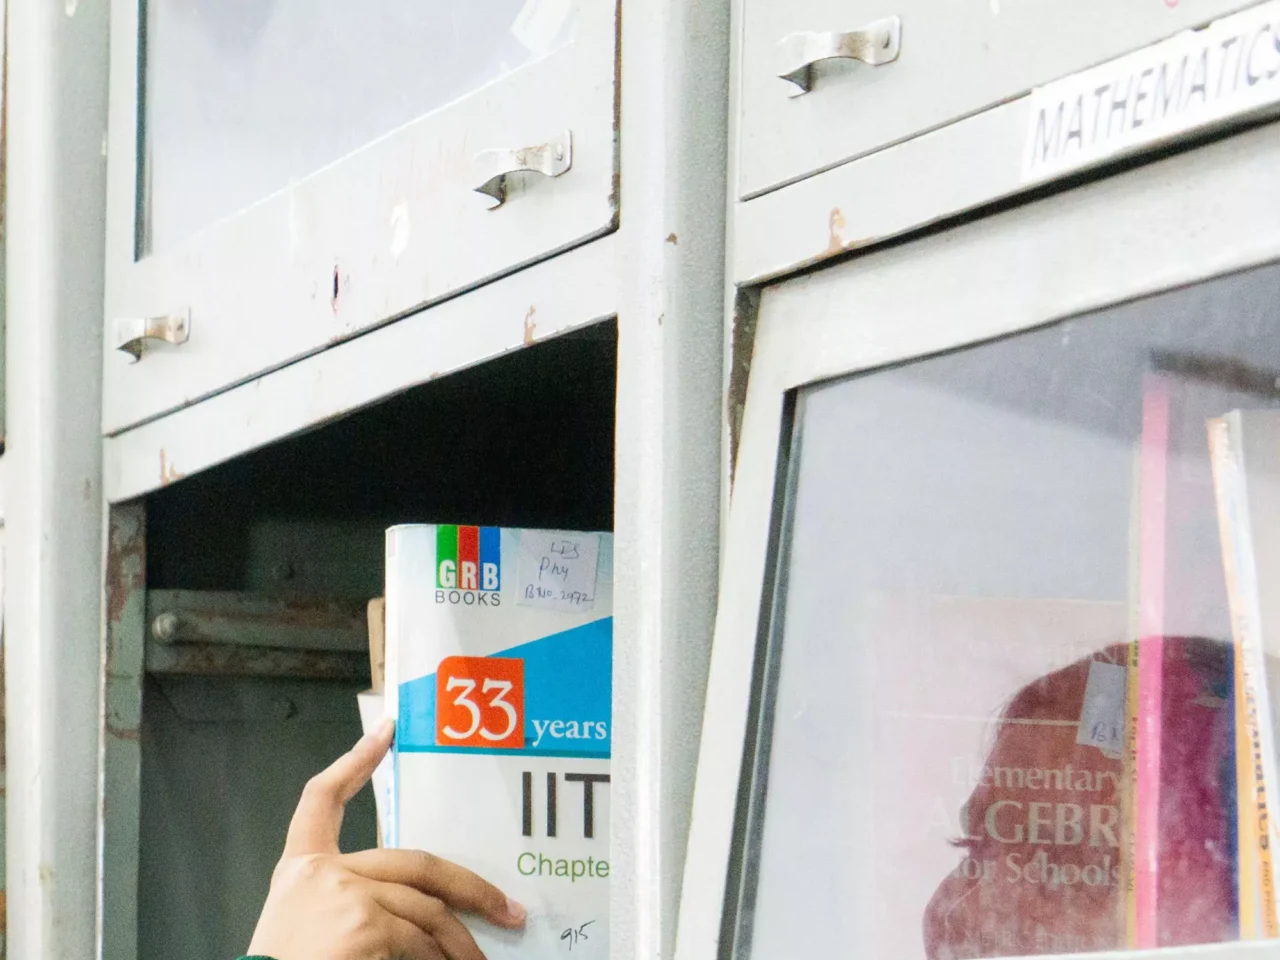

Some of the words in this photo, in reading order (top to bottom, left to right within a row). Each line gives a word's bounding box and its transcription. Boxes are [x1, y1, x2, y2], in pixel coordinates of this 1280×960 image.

[439, 558, 499, 590] GRB
[435, 590, 501, 607] BOOKS
[441, 676, 518, 742] 33
[531, 716, 607, 747] years
[521, 771, 611, 838] IIT
[517, 852, 610, 883] Chapte
[953, 856, 996, 881] or
[560, 919, 596, 952] 915
